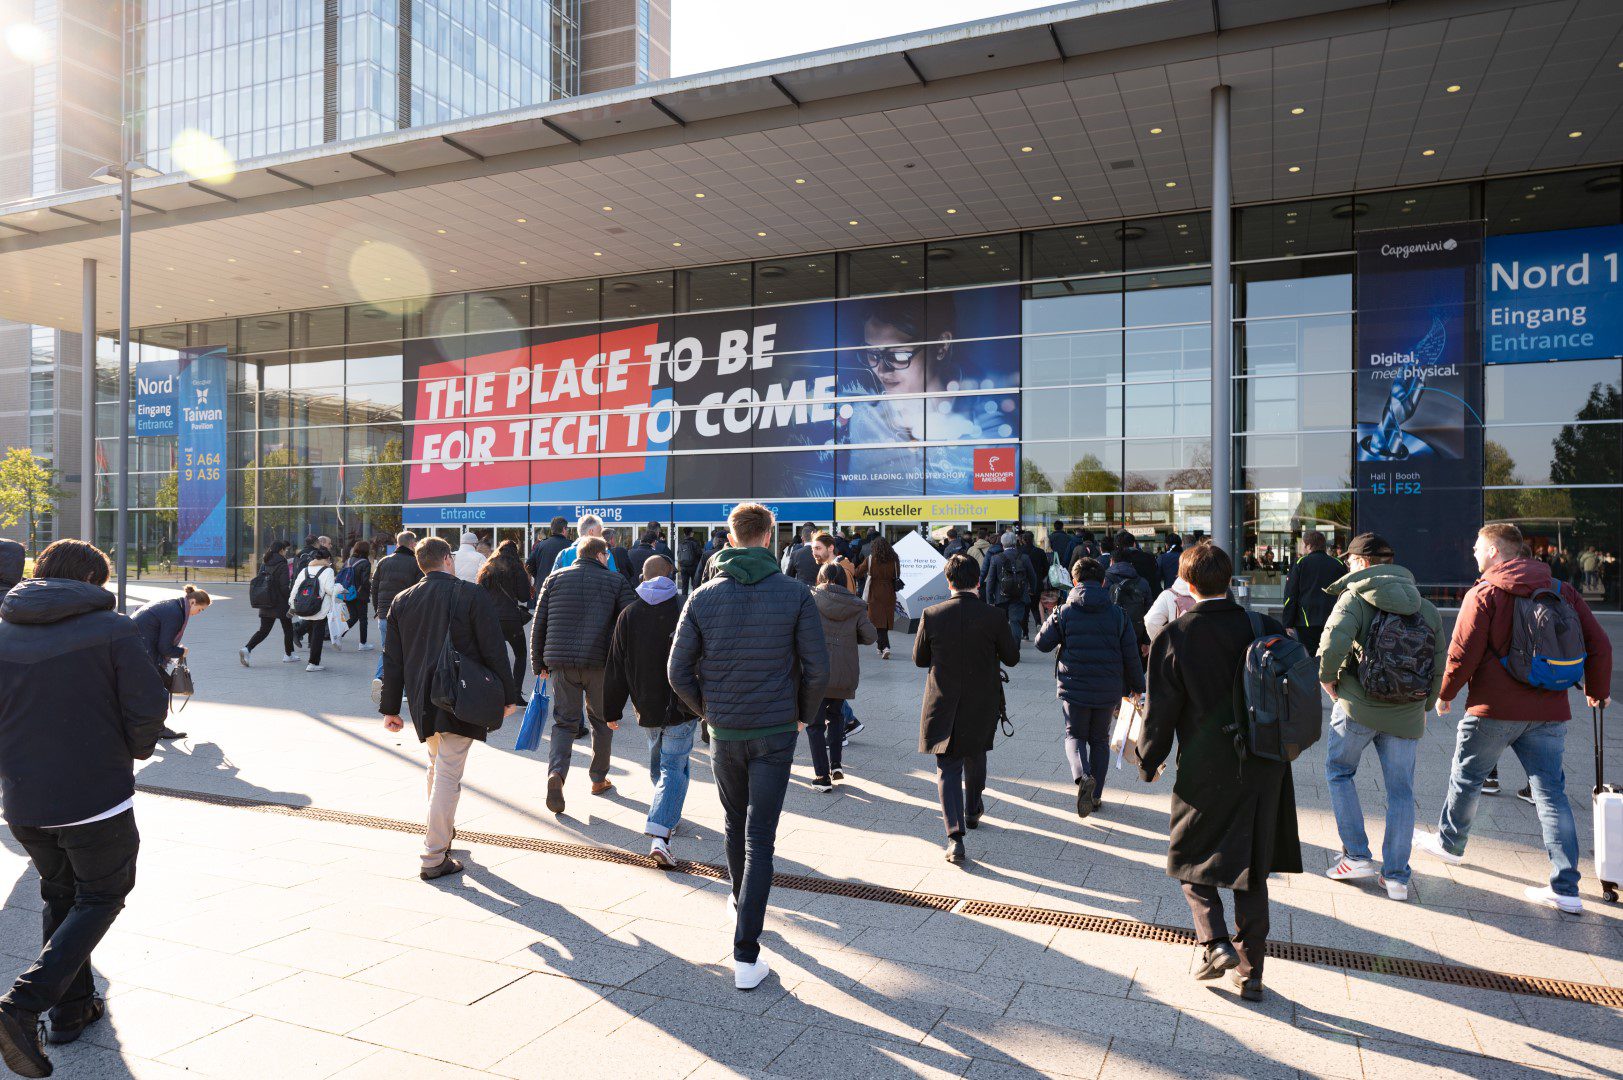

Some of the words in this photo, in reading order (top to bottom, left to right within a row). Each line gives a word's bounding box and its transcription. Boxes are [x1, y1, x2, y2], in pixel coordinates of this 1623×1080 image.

[1381, 241, 1443, 258] Capgemini
[1492, 253, 1589, 291] Nord
[1603, 253, 1618, 283] 1
[1491, 306, 1587, 329] Eingang
[1491, 333, 1594, 351] Entrance
[1370, 351, 1419, 367] Digital,
[425, 371, 496, 420] THE
[506, 348, 631, 408] PLACE
[644, 336, 703, 387] TO
[717, 323, 777, 376] BE
[1371, 367, 1402, 380] meet
[1403, 364, 1459, 381] physical.
[138, 374, 173, 395] Nord
[138, 404, 171, 417] Eingang
[183, 406, 223, 421] Taiwan
[138, 420, 174, 430] Entrance
[421, 426, 496, 473] FOR
[508, 409, 610, 458] TECH
[623, 398, 681, 447] TO
[695, 374, 853, 437] COME.
[185, 453, 193, 466] 3
[197, 453, 221, 466] A64
[185, 469, 193, 481] 9
[197, 468, 220, 481] A36
[870, 473, 904, 481] LEADING.
[1370, 472, 1386, 480] Hall
[1395, 472, 1421, 480] Booth
[1370, 482, 1386, 495] 15
[1395, 482, 1422, 495] F52
[440, 507, 487, 519] Entrance
[862, 503, 923, 516] Aussteller
[931, 503, 989, 516] Exhibitor
